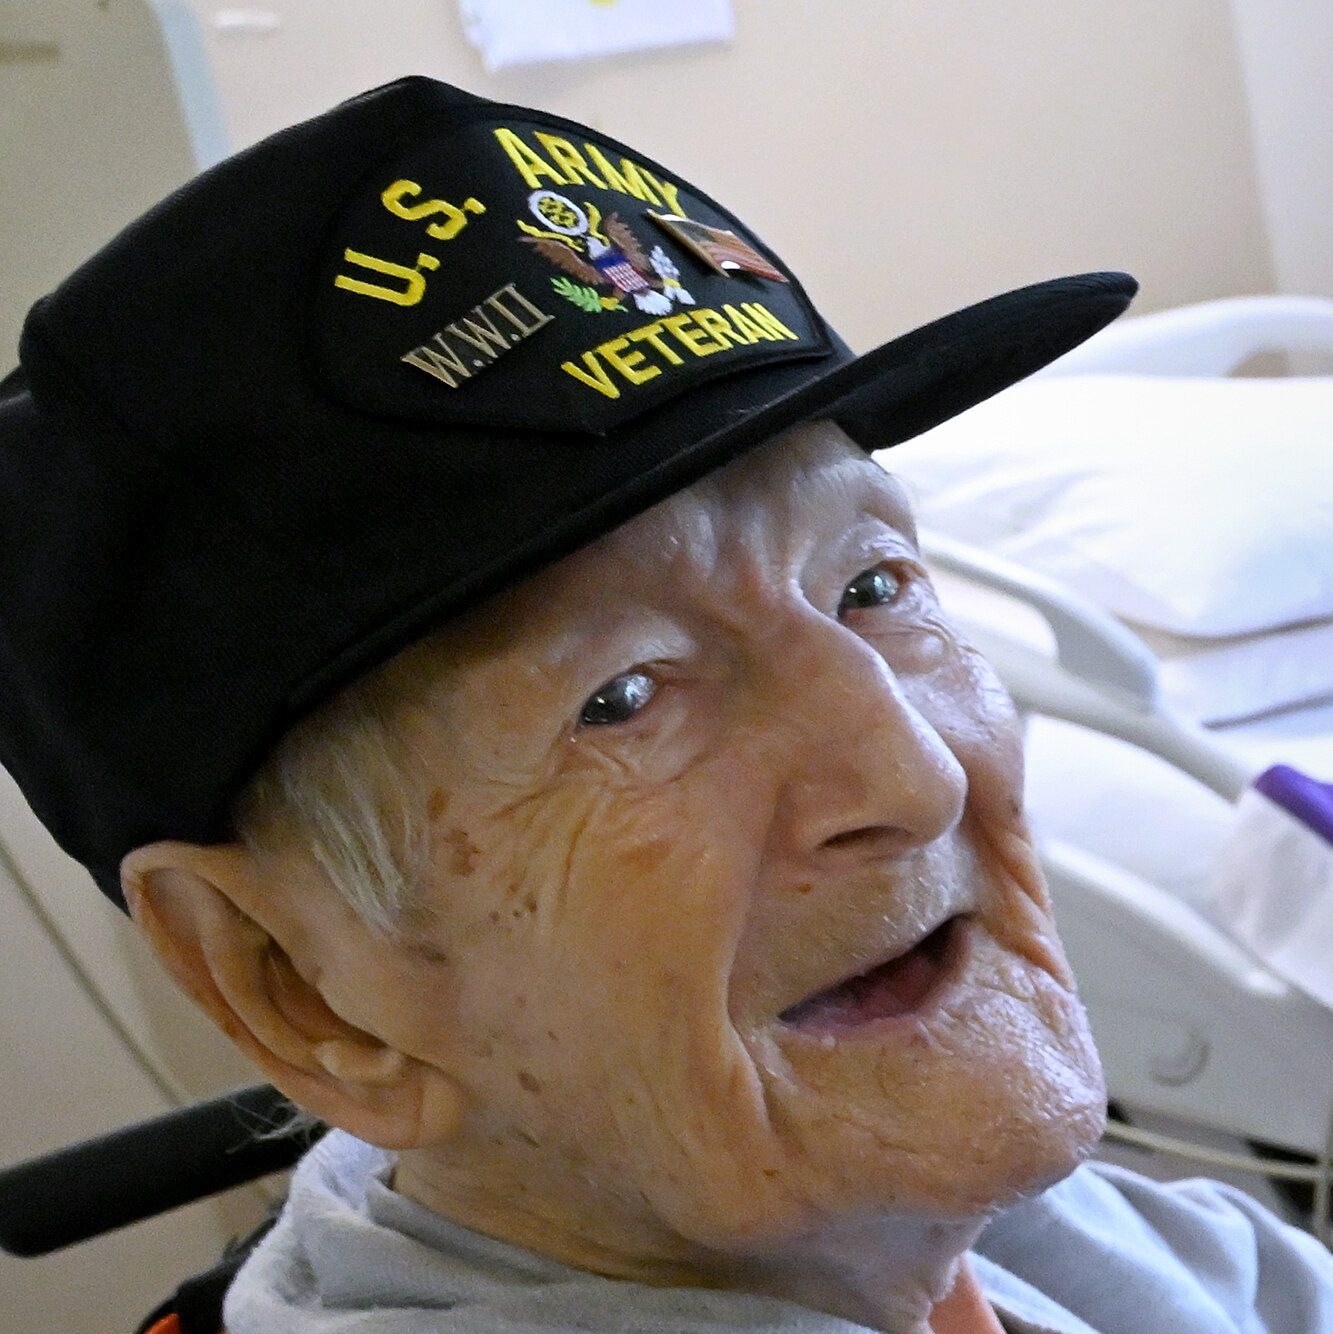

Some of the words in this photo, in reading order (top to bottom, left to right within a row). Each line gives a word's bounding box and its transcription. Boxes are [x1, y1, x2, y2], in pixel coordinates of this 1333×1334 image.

[333, 178, 487, 307] U.S.
[493, 127, 687, 219] ARMY
[560, 302, 799, 400] VETERAN
